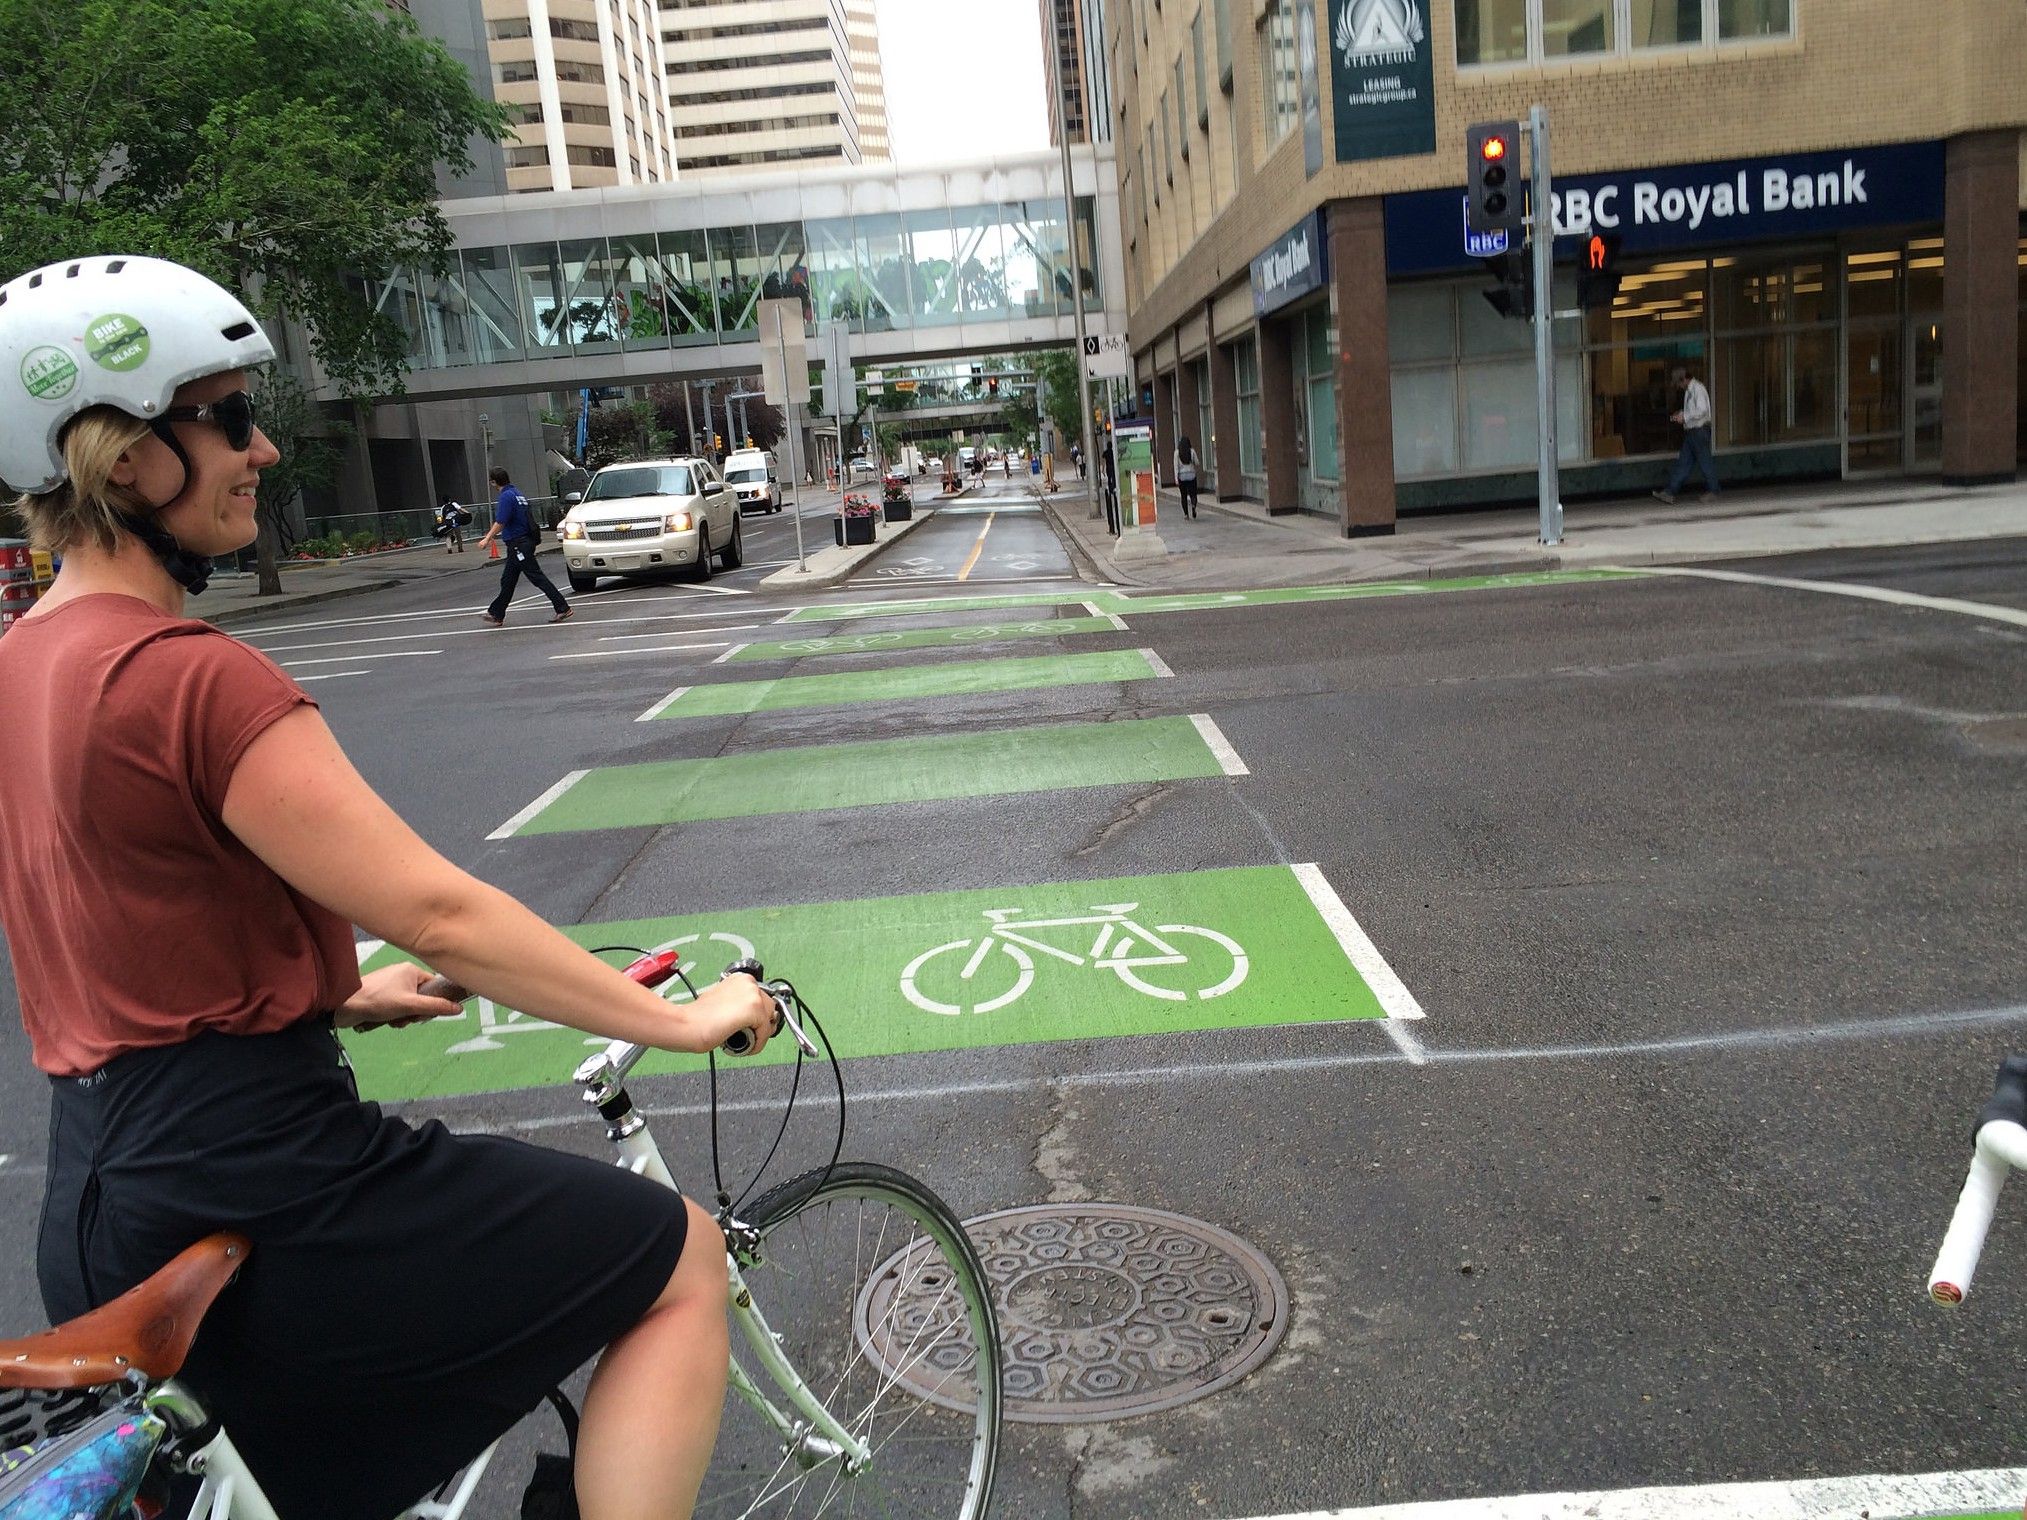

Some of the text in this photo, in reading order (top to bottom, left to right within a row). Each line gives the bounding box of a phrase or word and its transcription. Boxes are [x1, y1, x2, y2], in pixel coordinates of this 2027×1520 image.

[1344, 49, 1416, 69] STRATEGIC
[1363, 75, 1401, 93] LEASING
[1551, 158, 1868, 233] RBC Royal Bank
[1470, 230, 1504, 253] RBC
[92, 318, 125, 340] BIKE
[110, 344, 142, 365] BLACK
